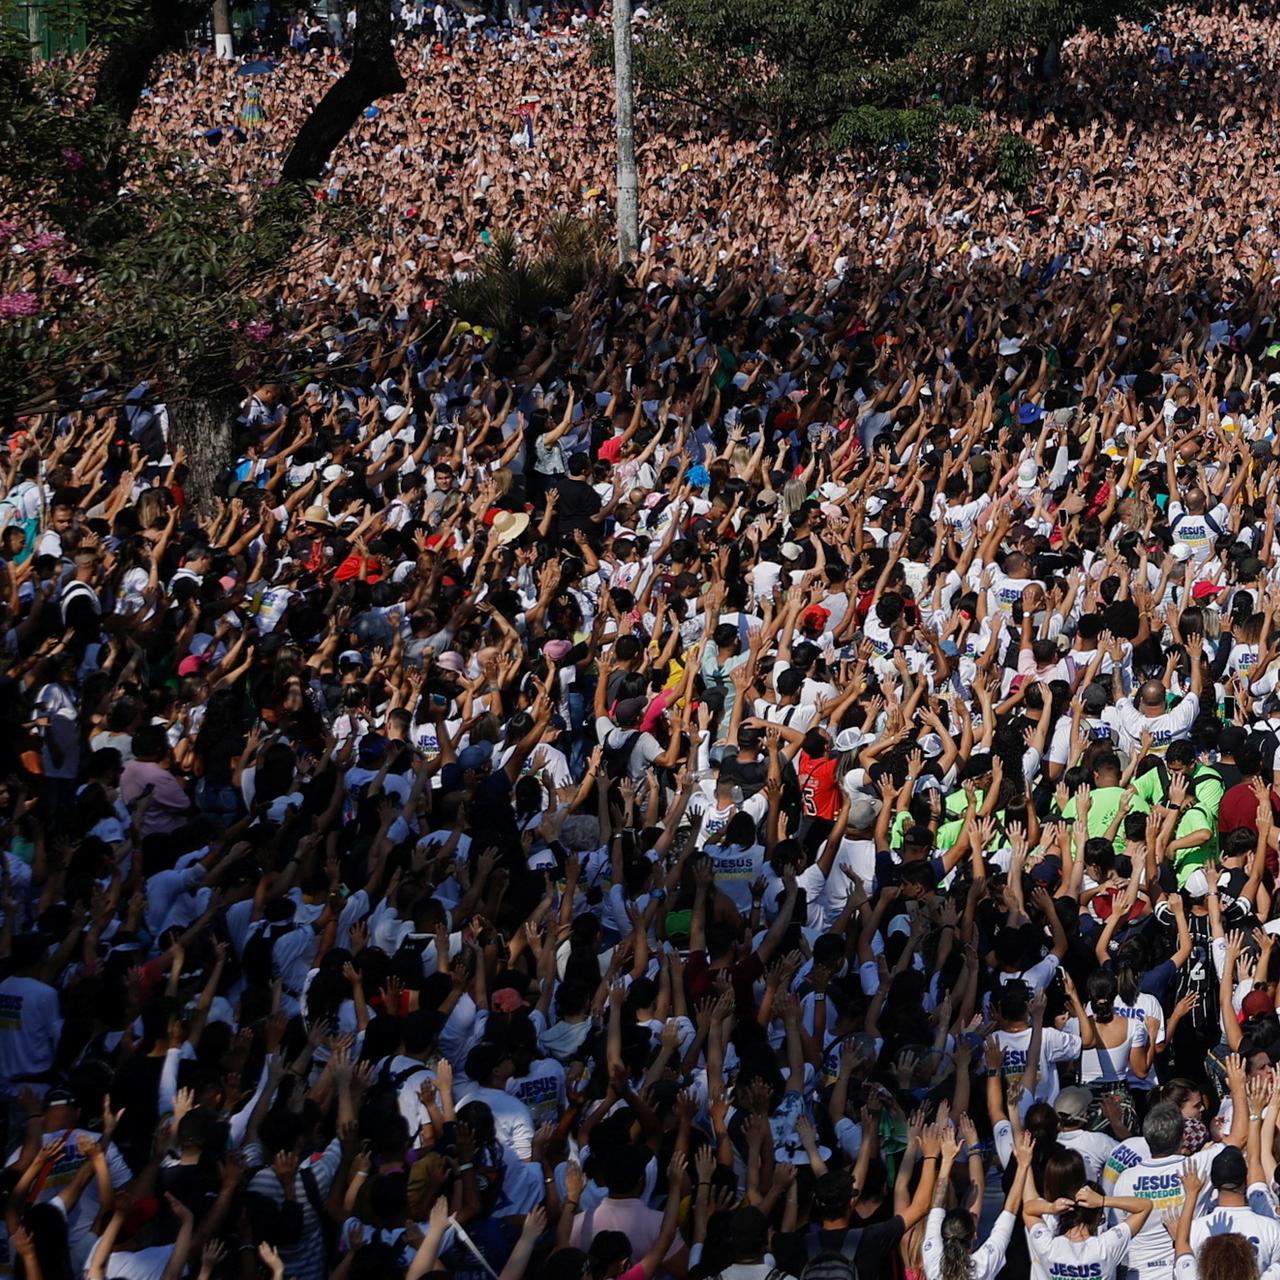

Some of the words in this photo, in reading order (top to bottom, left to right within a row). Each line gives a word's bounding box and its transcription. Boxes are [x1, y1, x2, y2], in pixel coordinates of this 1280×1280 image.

[714, 857, 753, 867] JESUS
[516, 1077, 557, 1099] JESUS
[1110, 1145, 1143, 1168] JESUS
[1132, 1174, 1181, 1190] JESUS
[1133, 1187, 1181, 1199] VENCEDOR
[1049, 1262, 1101, 1277] JESUS
